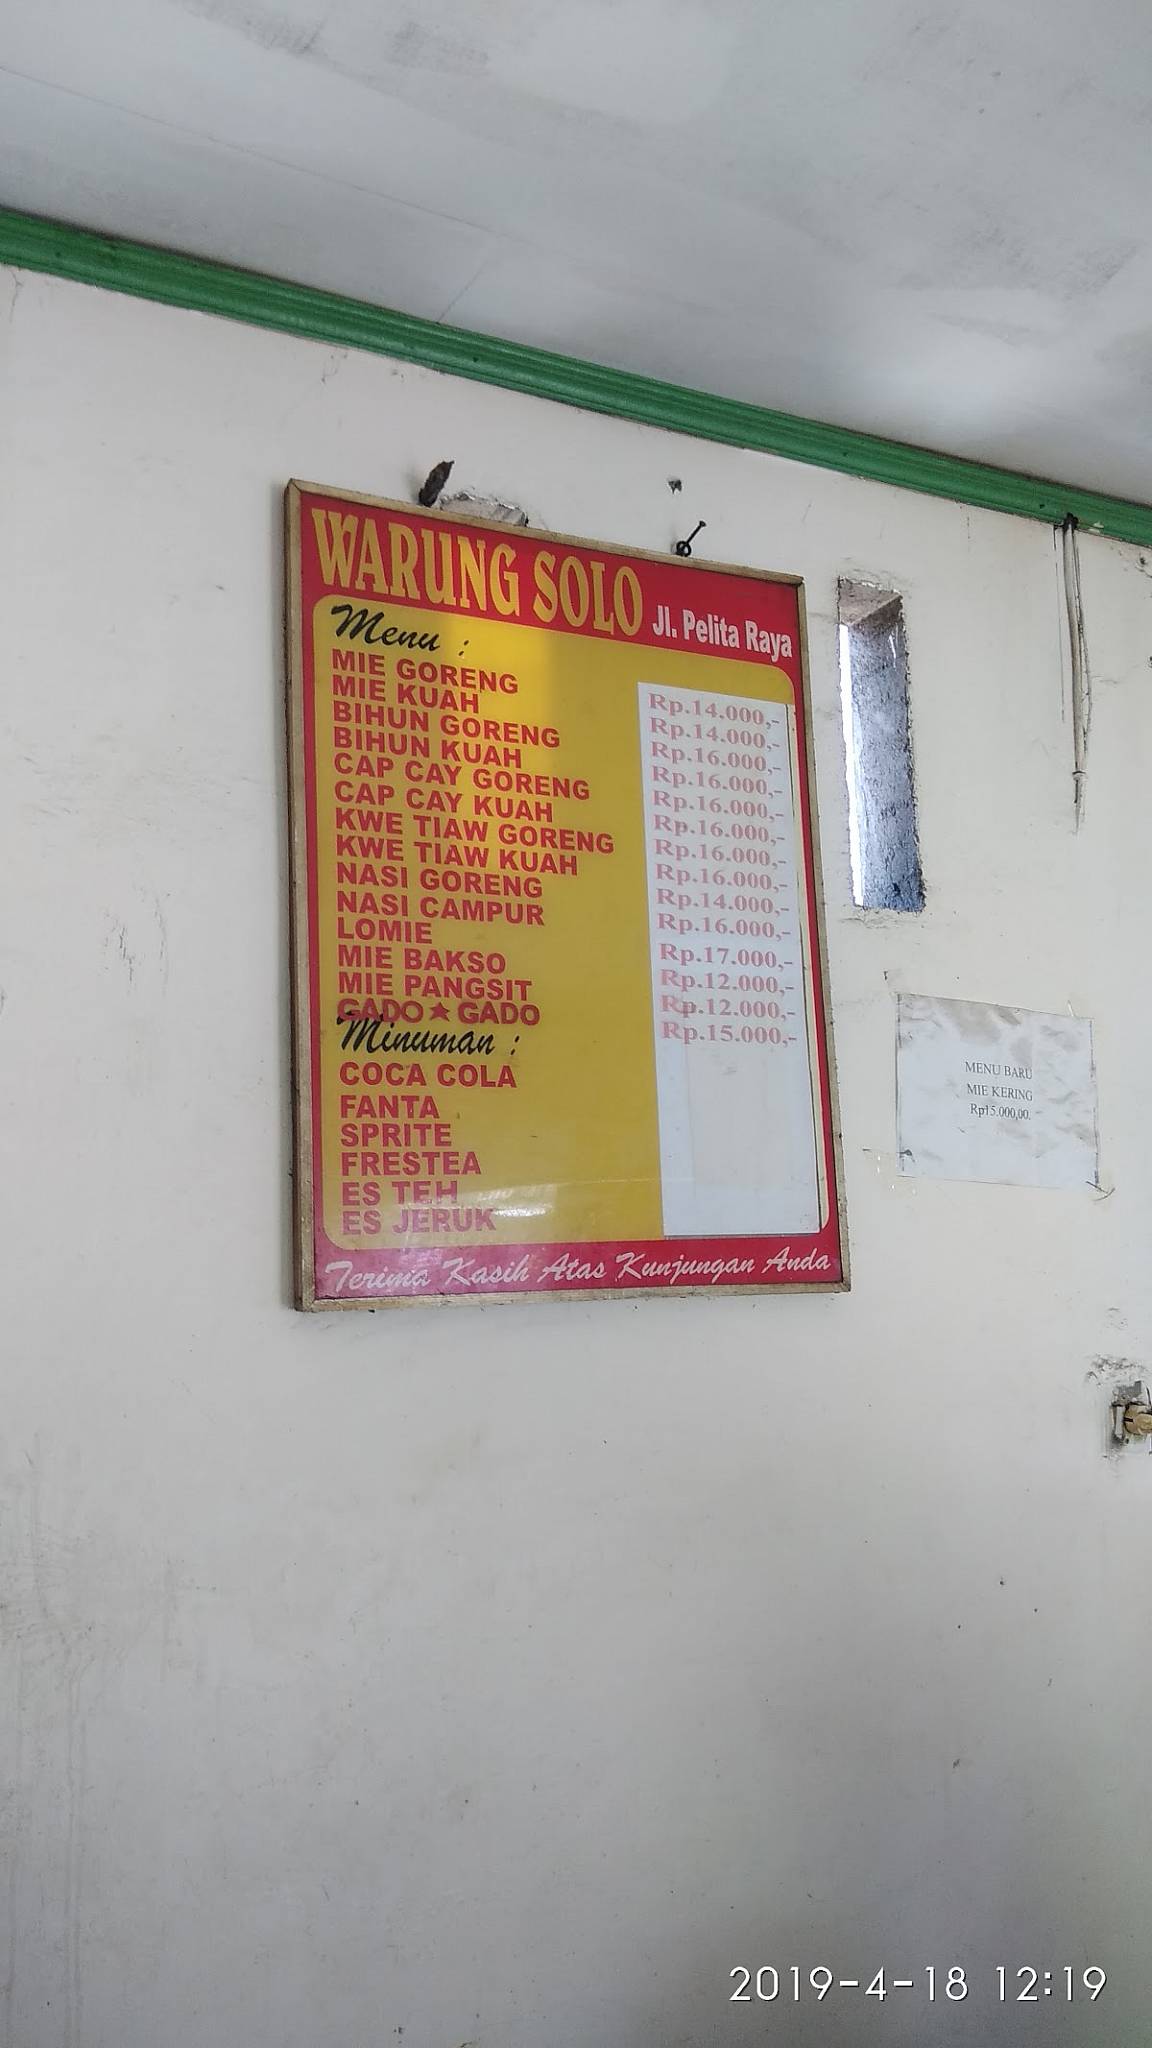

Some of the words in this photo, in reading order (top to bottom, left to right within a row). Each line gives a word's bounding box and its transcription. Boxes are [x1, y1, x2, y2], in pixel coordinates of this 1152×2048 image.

[311, 508, 520, 616] WARUNG
[532, 550, 644, 637] SOLO
[331, 604, 441, 654] Menu
[652, 605, 678, 639] Jl.
[682, 609, 740, 649] Pelita
[745, 620, 793, 663] Raya
[332, 648, 384, 678] MIE
[397, 658, 519, 694] GORENG
[332, 675, 384, 702] MIE
[398, 683, 479, 713] KUAH
[648, 692, 780, 729] Rp.14.000,-
[333, 700, 430, 731] BIHUN
[441, 714, 560, 748] GORENG
[649, 717, 781, 752] Rp.14.000,-
[333, 727, 430, 757] BIHUN
[441, 738, 521, 769] KUAH
[650, 741, 782, 776] Rp.16.000,-
[333, 753, 393, 779] CAP
[404, 760, 461, 787] CAY
[473, 769, 590, 800] GORENG
[651, 765, 782, 799] Rp.16.000,-
[334, 780, 393, 805] CAP
[405, 788, 462, 813] CAY
[473, 796, 553, 823] KUAH
[652, 789, 783, 823] Rp.16.000,-
[335, 808, 403, 834] KWE
[413, 815, 489, 842] TIAW
[499, 825, 614, 854] GORENG
[653, 813, 785, 847] Rp.16.000,-
[336, 835, 403, 861] KWE
[414, 842, 490, 868] TIAW
[500, 851, 578, 876] KUAH
[654, 838, 786, 871] Rp.16.000,-
[336, 862, 408, 889] NASI
[419, 870, 543, 898] GORENG
[656, 863, 787, 895] Rp.16.000,-
[337, 891, 409, 917] NASI
[420, 897, 545, 926] CAMPUR
[657, 888, 789, 917] Rp.14.000,-
[337, 918, 433, 944] LOMIE
[657, 914, 791, 941] Rp.16.000,-
[338, 944, 392, 969] MIE
[404, 949, 506, 974] BAKSO
[659, 943, 793, 970] Rp.17.000,-
[338, 972, 393, 997] MIE
[404, 976, 532, 1001] PANGSIT
[660, 968, 794, 995] Rp.12.000,-
[661, 995, 796, 1021] Rp.12.000,-
[337, 1011, 495, 1054] Minuman
[662, 1020, 797, 1046] Rp.15.000,-
[339, 1062, 427, 1087] COCA
[437, 1063, 517, 1088] COLA
[965, 1061, 1000, 1075] MENU
[1004, 1065, 1032, 1079] BARU
[340, 1095, 440, 1120] FANTA
[967, 1083, 988, 1096] MIE
[992, 1087, 1033, 1101] KERING
[341, 1124, 452, 1147] SPRITE
[341, 1152, 481, 1176] FRESTEA
[342, 1182, 380, 1207] ES
[391, 1181, 458, 1205] TEH
[342, 1210, 381, 1235] ES
[392, 1206, 496, 1233] JERUK
[325, 1261, 431, 1292] Terima
[442, 1254, 530, 1285] Kasih
[538, 1252, 606, 1281] Atas
[614, 1252, 755, 1286] Kunjungan
[762, 1247, 831, 1272] Anda
